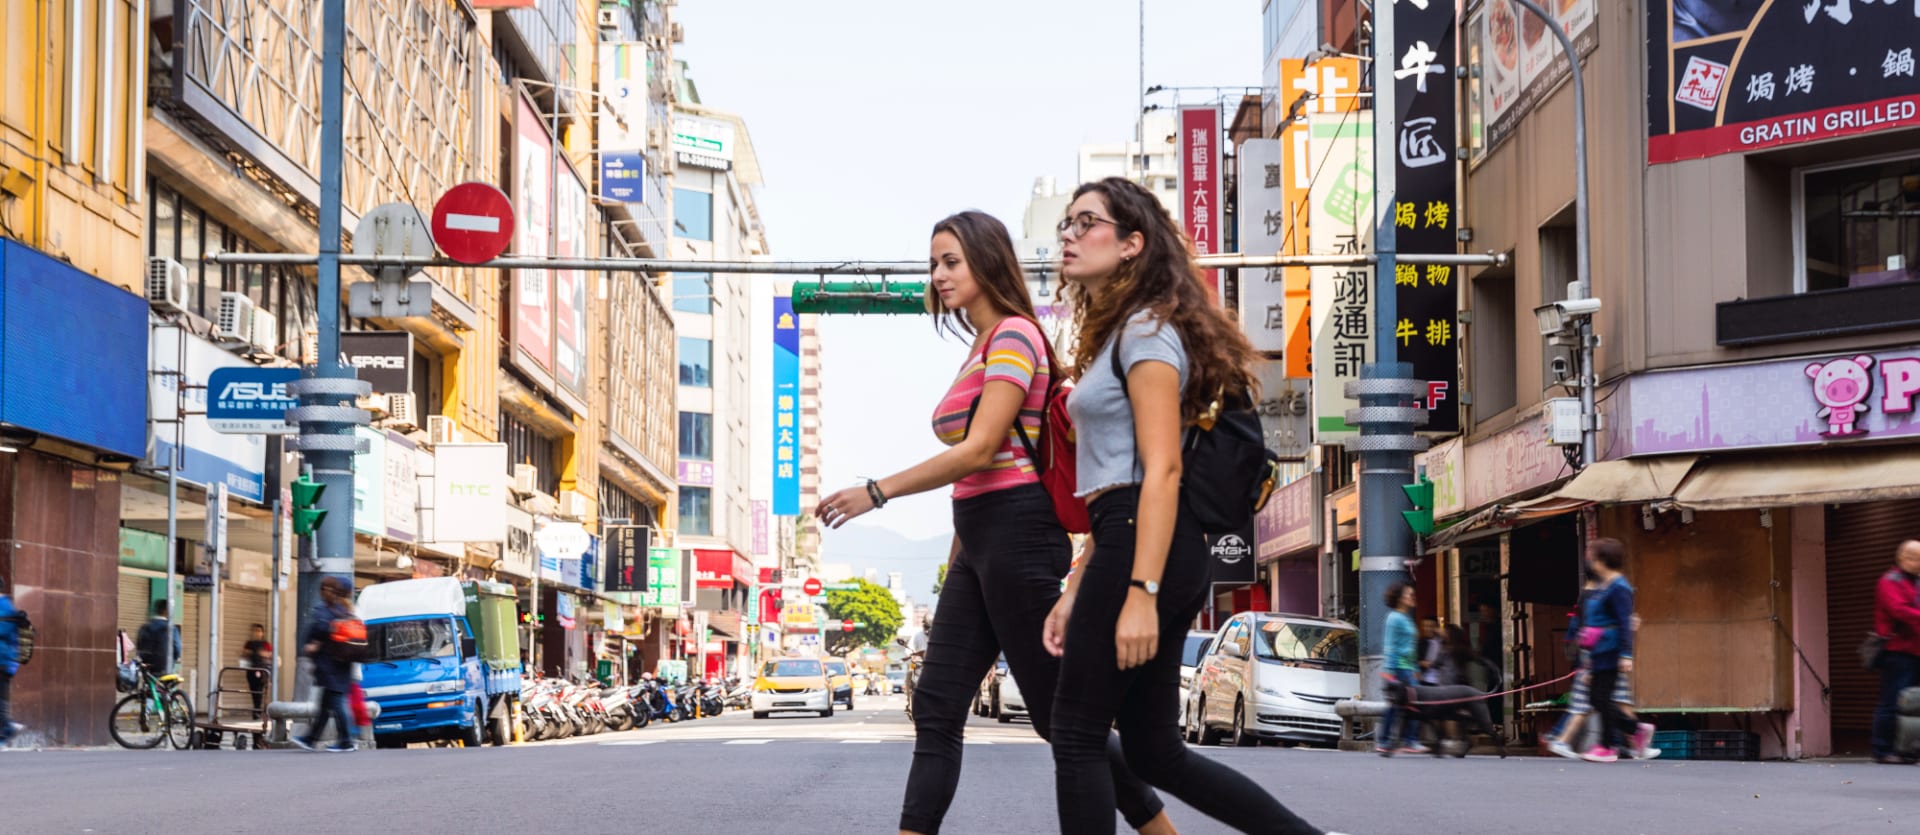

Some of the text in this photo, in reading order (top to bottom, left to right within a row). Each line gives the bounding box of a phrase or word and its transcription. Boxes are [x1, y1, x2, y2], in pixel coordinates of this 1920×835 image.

[1394, 0, 1446, 168] 牛匠
[1739, 100, 1916, 145] GRATIN GRILLED
[1394, 200, 1450, 229] 焗烤
[1395, 263, 1451, 288] 鍋物
[1395, 318, 1452, 347] 牛排
[218, 381, 296, 401] ASUS
